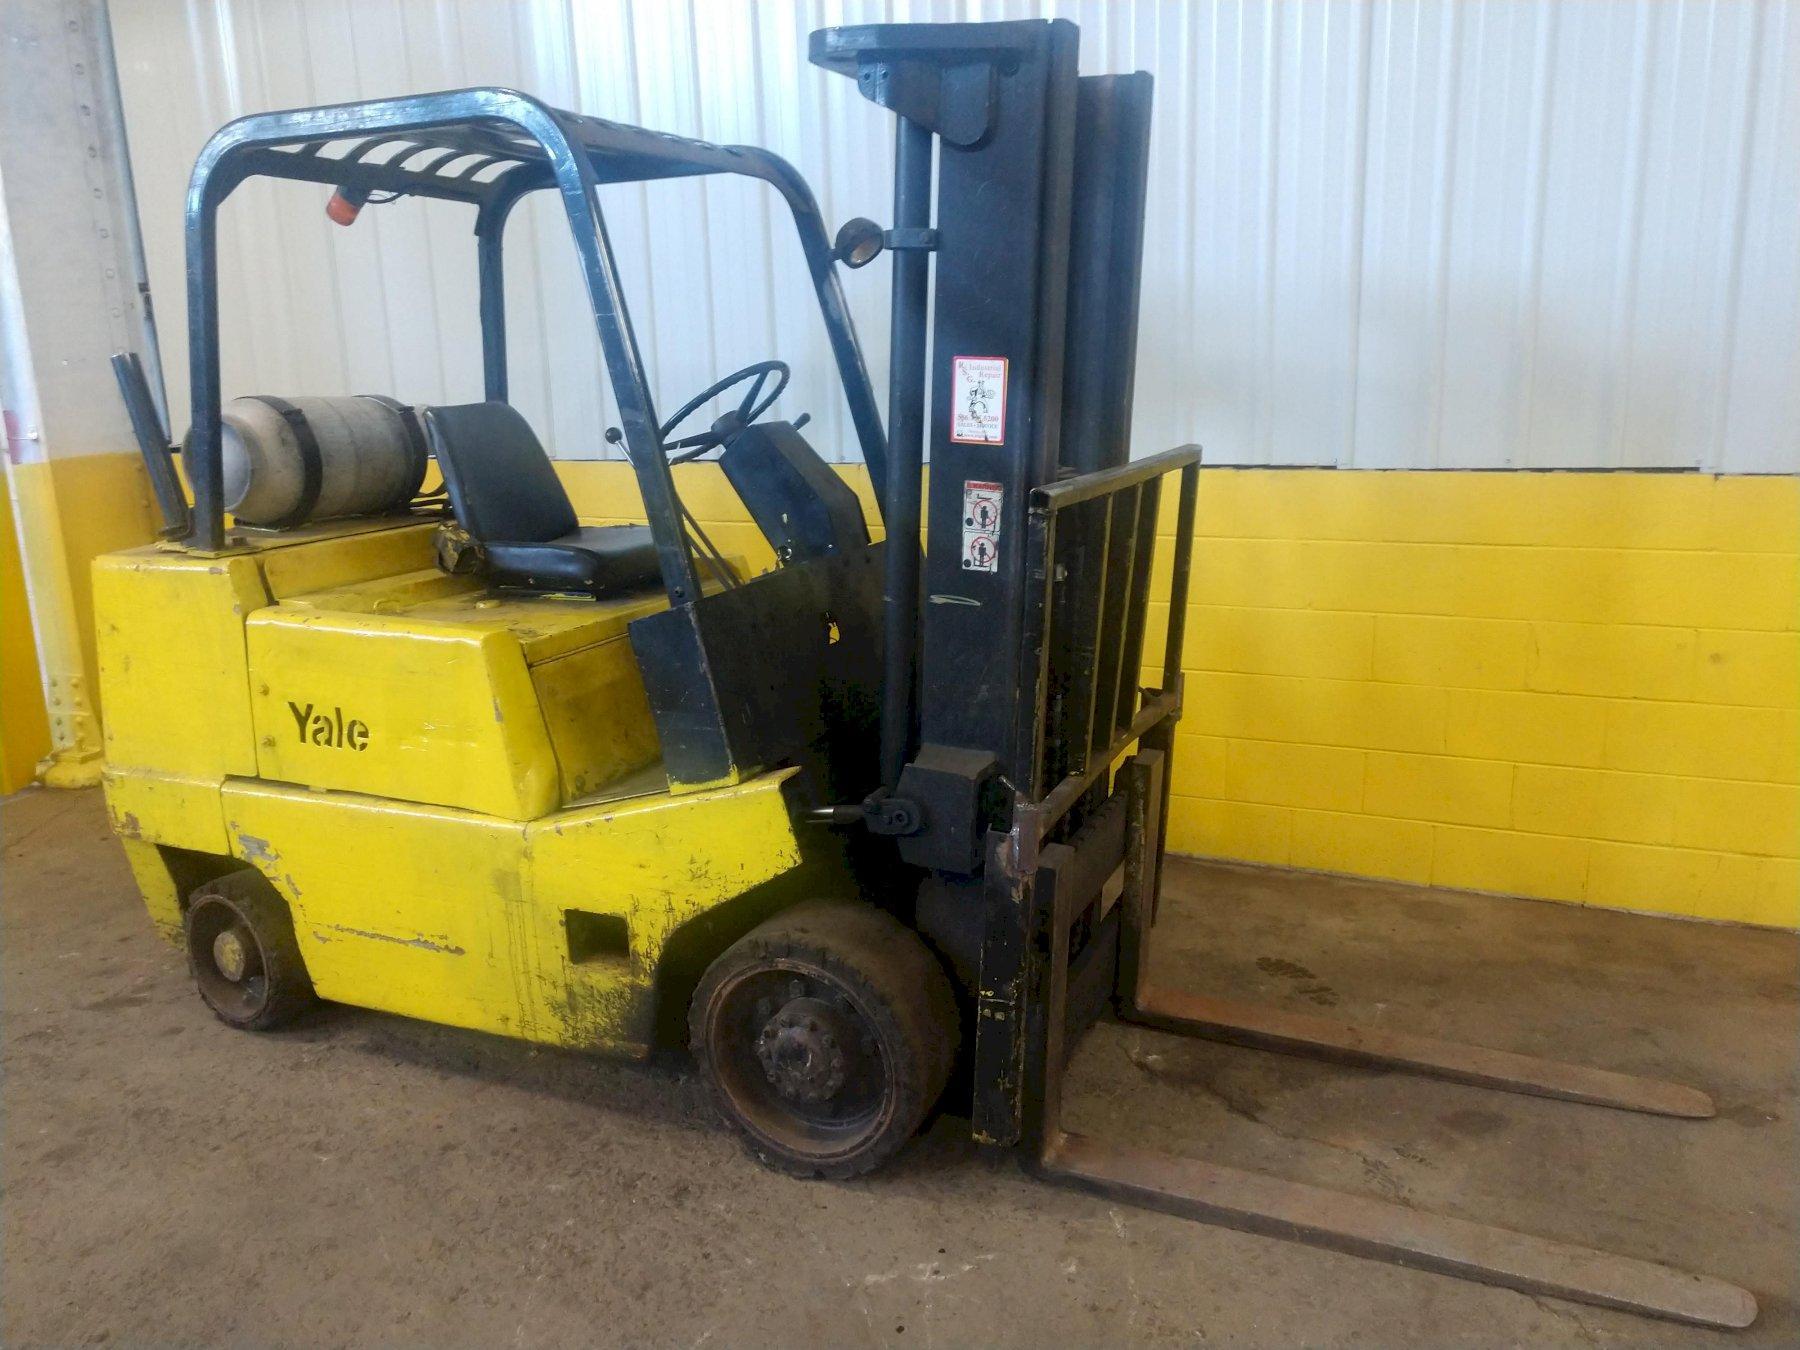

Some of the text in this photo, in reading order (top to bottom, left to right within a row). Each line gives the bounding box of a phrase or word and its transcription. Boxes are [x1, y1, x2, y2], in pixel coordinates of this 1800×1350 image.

[969, 363, 1002, 371] Industrial
[979, 371, 1001, 379] Repair
[288, 702, 369, 751] Yale
